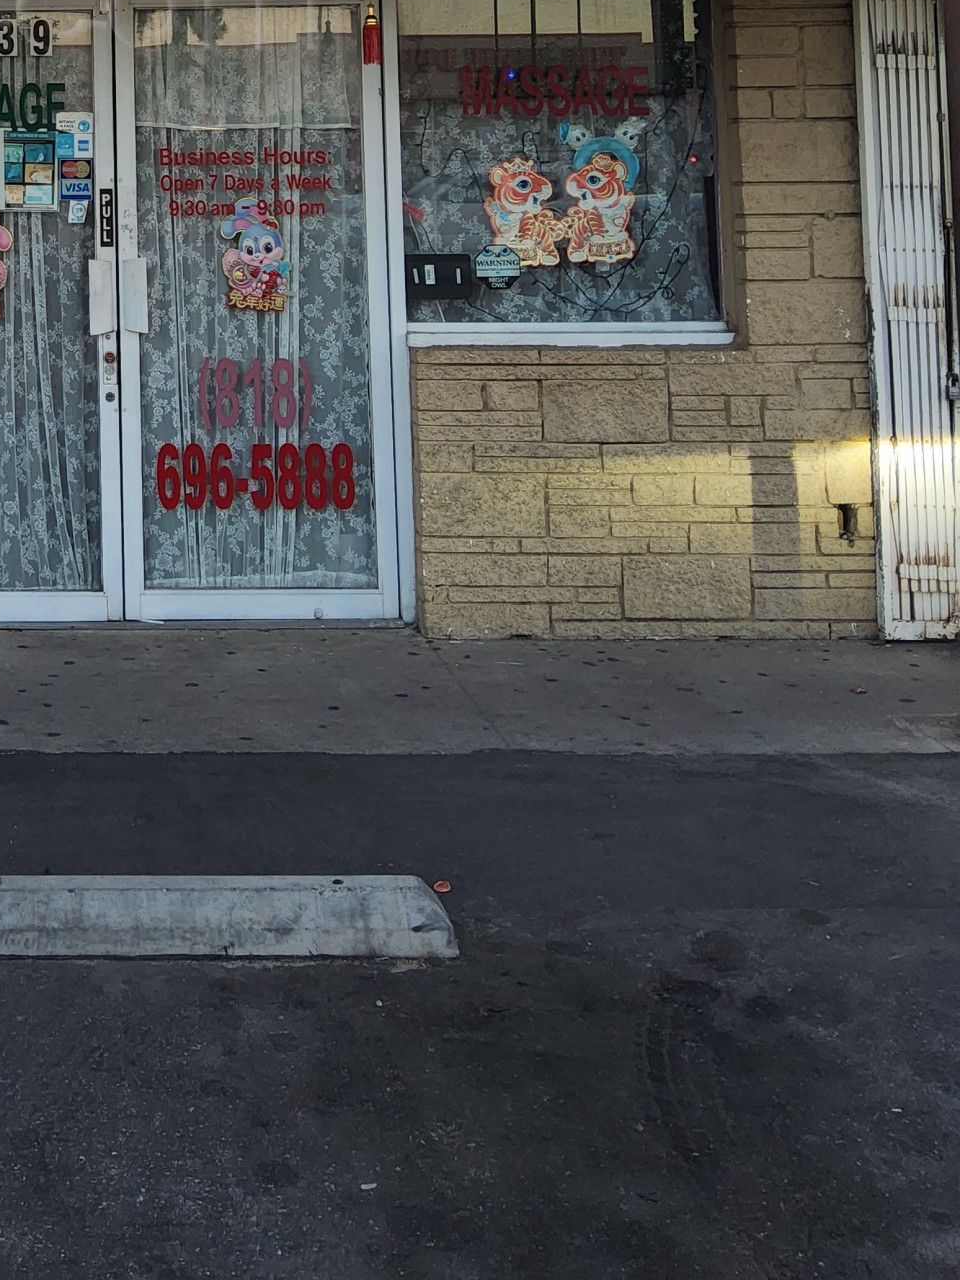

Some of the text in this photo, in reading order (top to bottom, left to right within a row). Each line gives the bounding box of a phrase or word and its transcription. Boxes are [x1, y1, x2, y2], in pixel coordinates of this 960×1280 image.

[459, 63, 651, 117] MASSAGE
[159, 146, 333, 166] Business Hours:
[65, 183, 90, 193] VISA
[160, 173, 332, 193] Open 7 Days a Week
[101, 193, 111, 243] PULL
[169, 199, 206, 216] 9:30
[209, 202, 236, 216] am
[257, 199, 295, 216] 9:30
[300, 202, 326, 218] pm
[476, 259, 520, 267] WARNING
[198, 356, 313, 431] (818)
[156, 442, 356, 511] 696-5888
